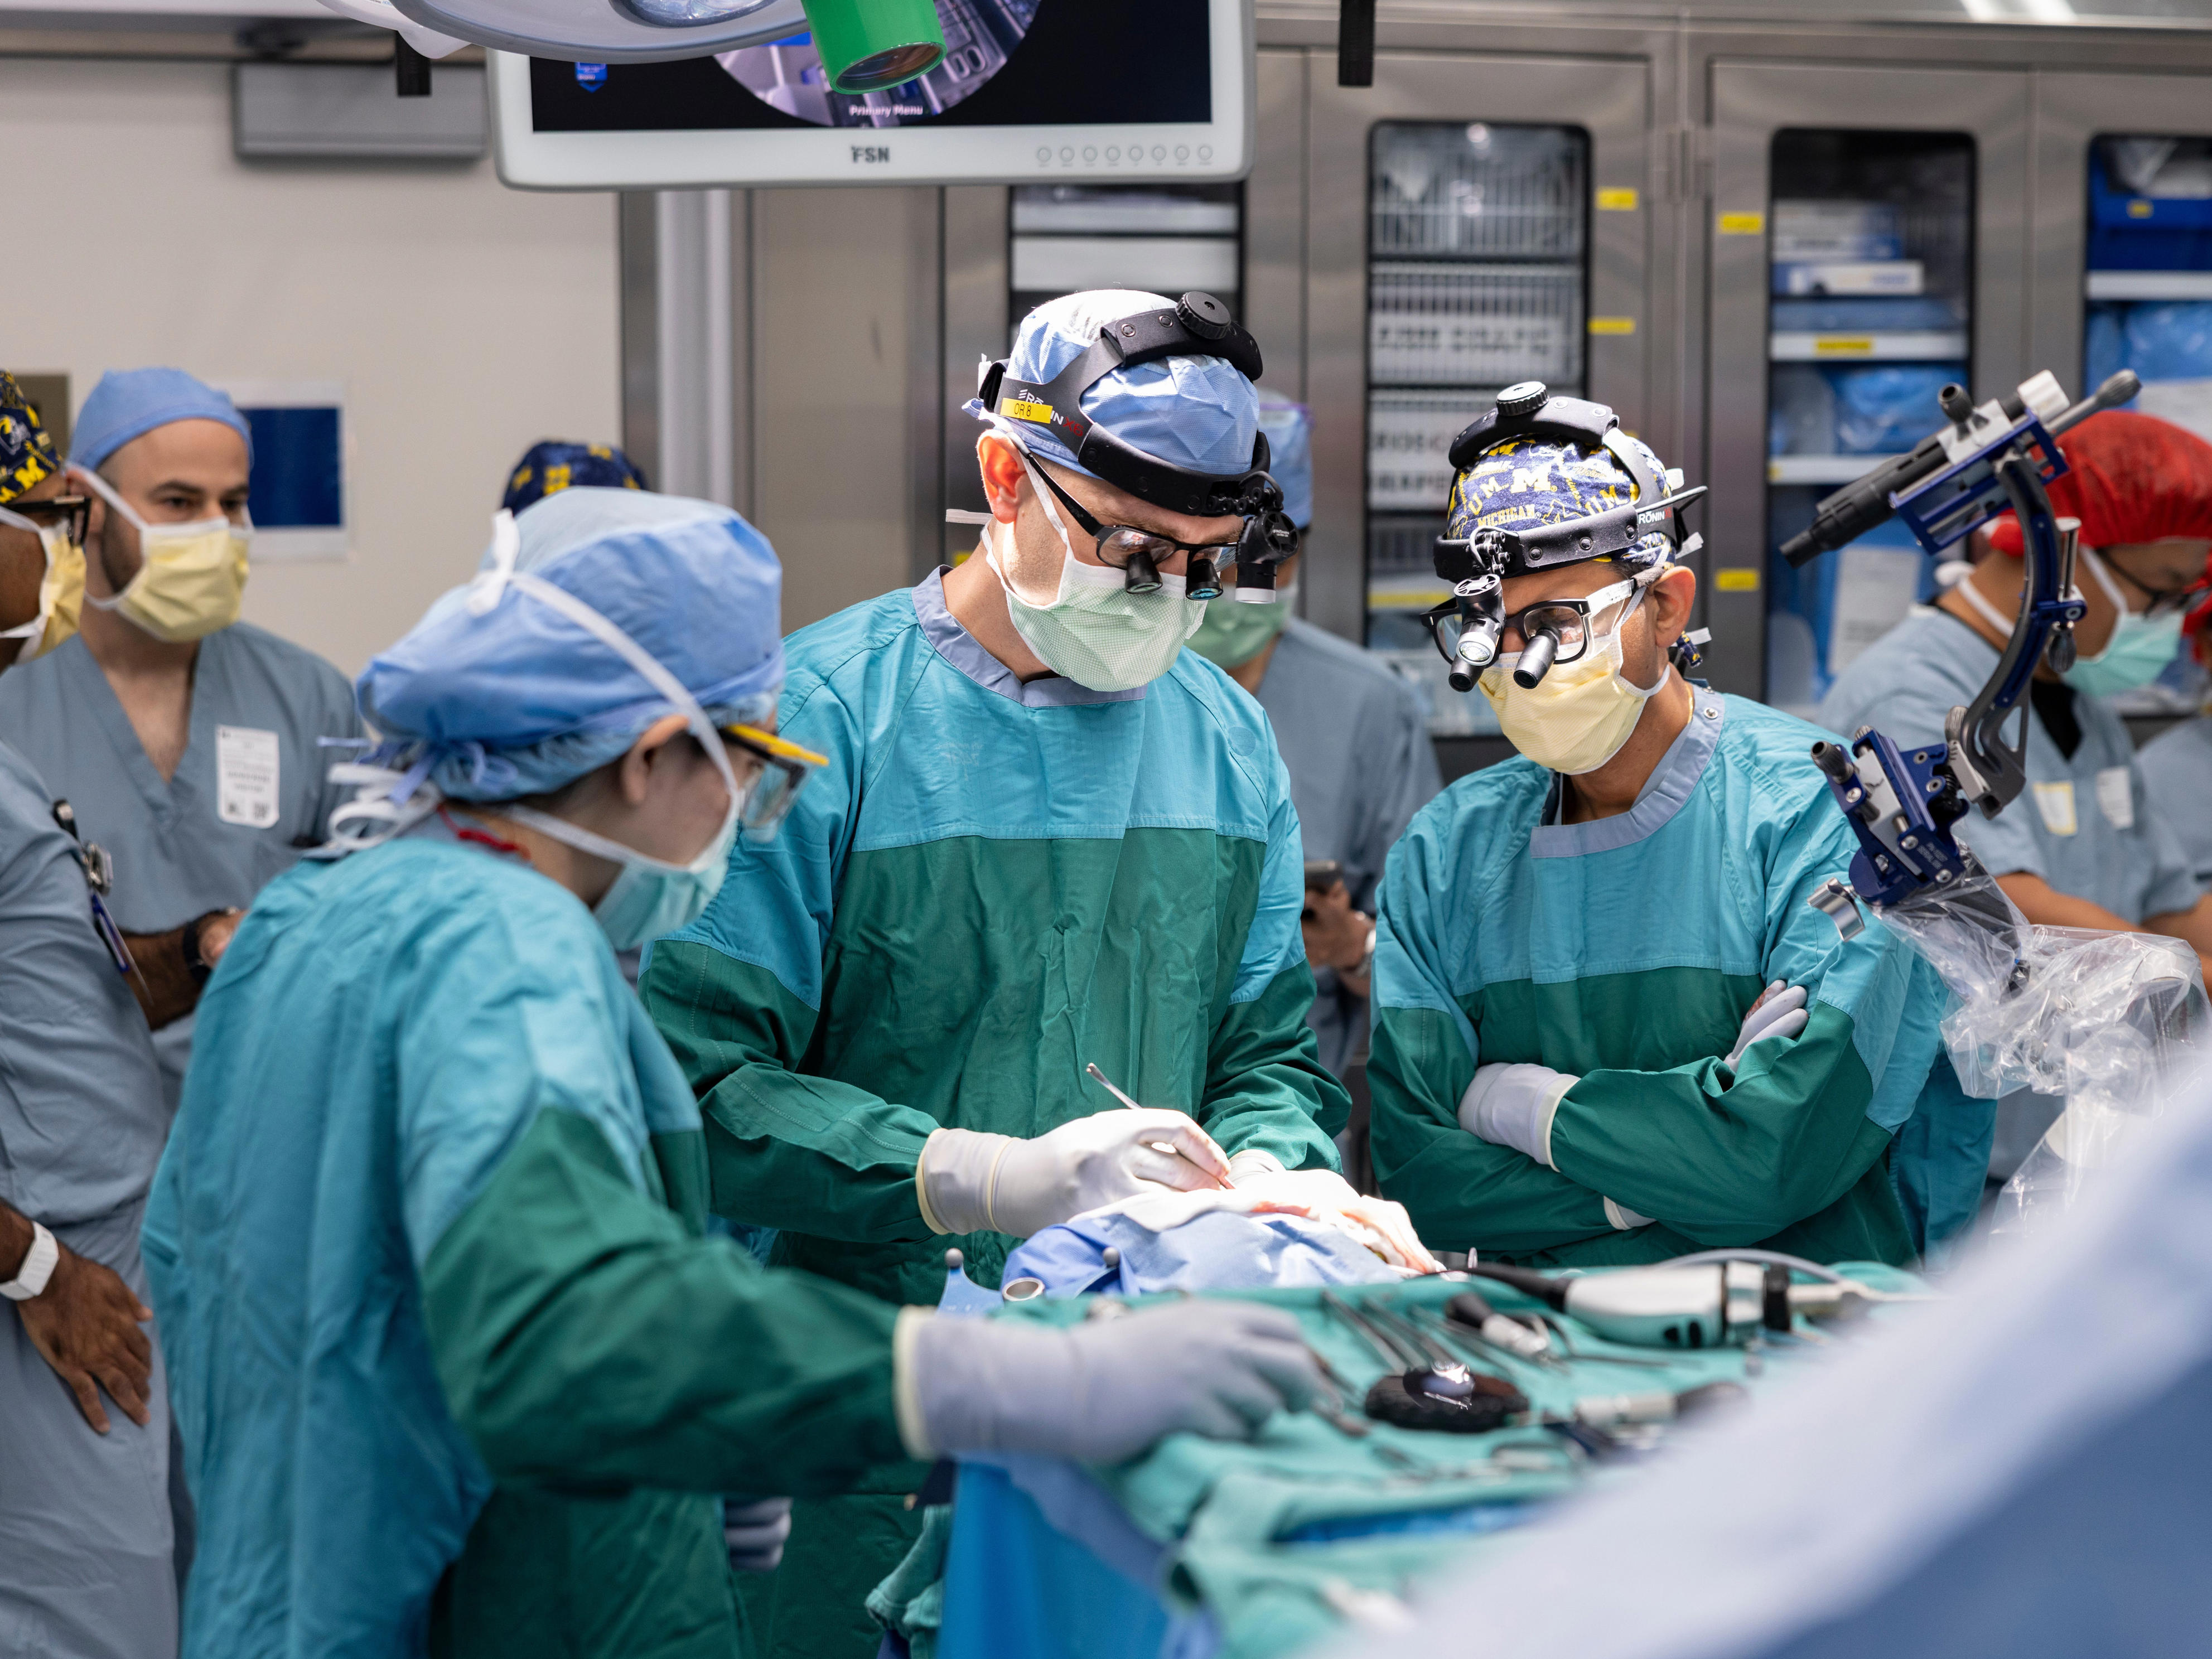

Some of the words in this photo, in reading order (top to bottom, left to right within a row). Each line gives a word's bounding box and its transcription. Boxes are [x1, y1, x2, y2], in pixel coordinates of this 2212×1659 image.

[849, 104, 892, 118] Primary
[893, 104, 923, 115] Menu
[851, 146, 890, 163] FSN
[1014, 403, 1025, 416] OR
[1026, 405, 1032, 417] 8
[1510, 463, 1551, 494] M
[1477, 504, 1535, 526] MICHIGAN
